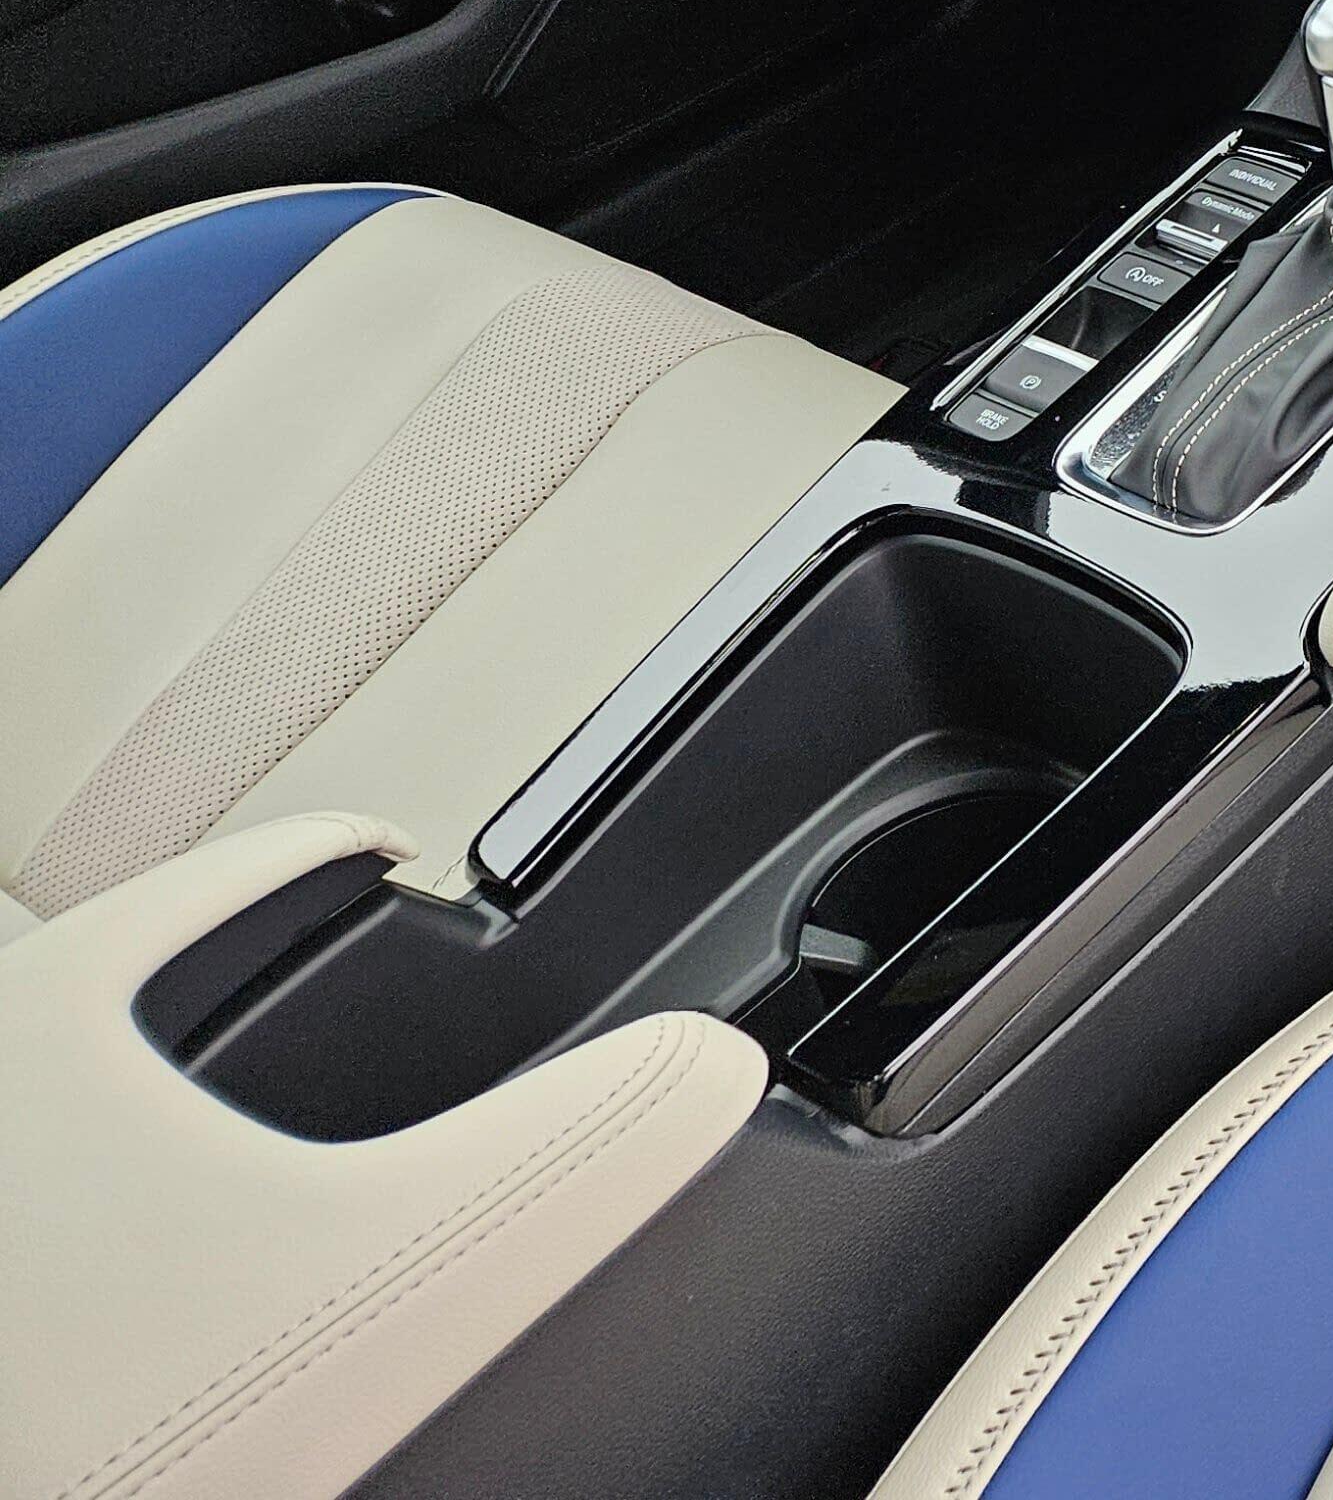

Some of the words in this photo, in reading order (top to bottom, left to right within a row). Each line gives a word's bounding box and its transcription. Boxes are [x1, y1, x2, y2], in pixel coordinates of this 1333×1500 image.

[1229, 169, 1277, 191] INDIVIDUAL
[1143, 275, 1164, 287] OFF
[976, 416, 1000, 431] HOLD
[980, 408, 1009, 426] BRAKE
